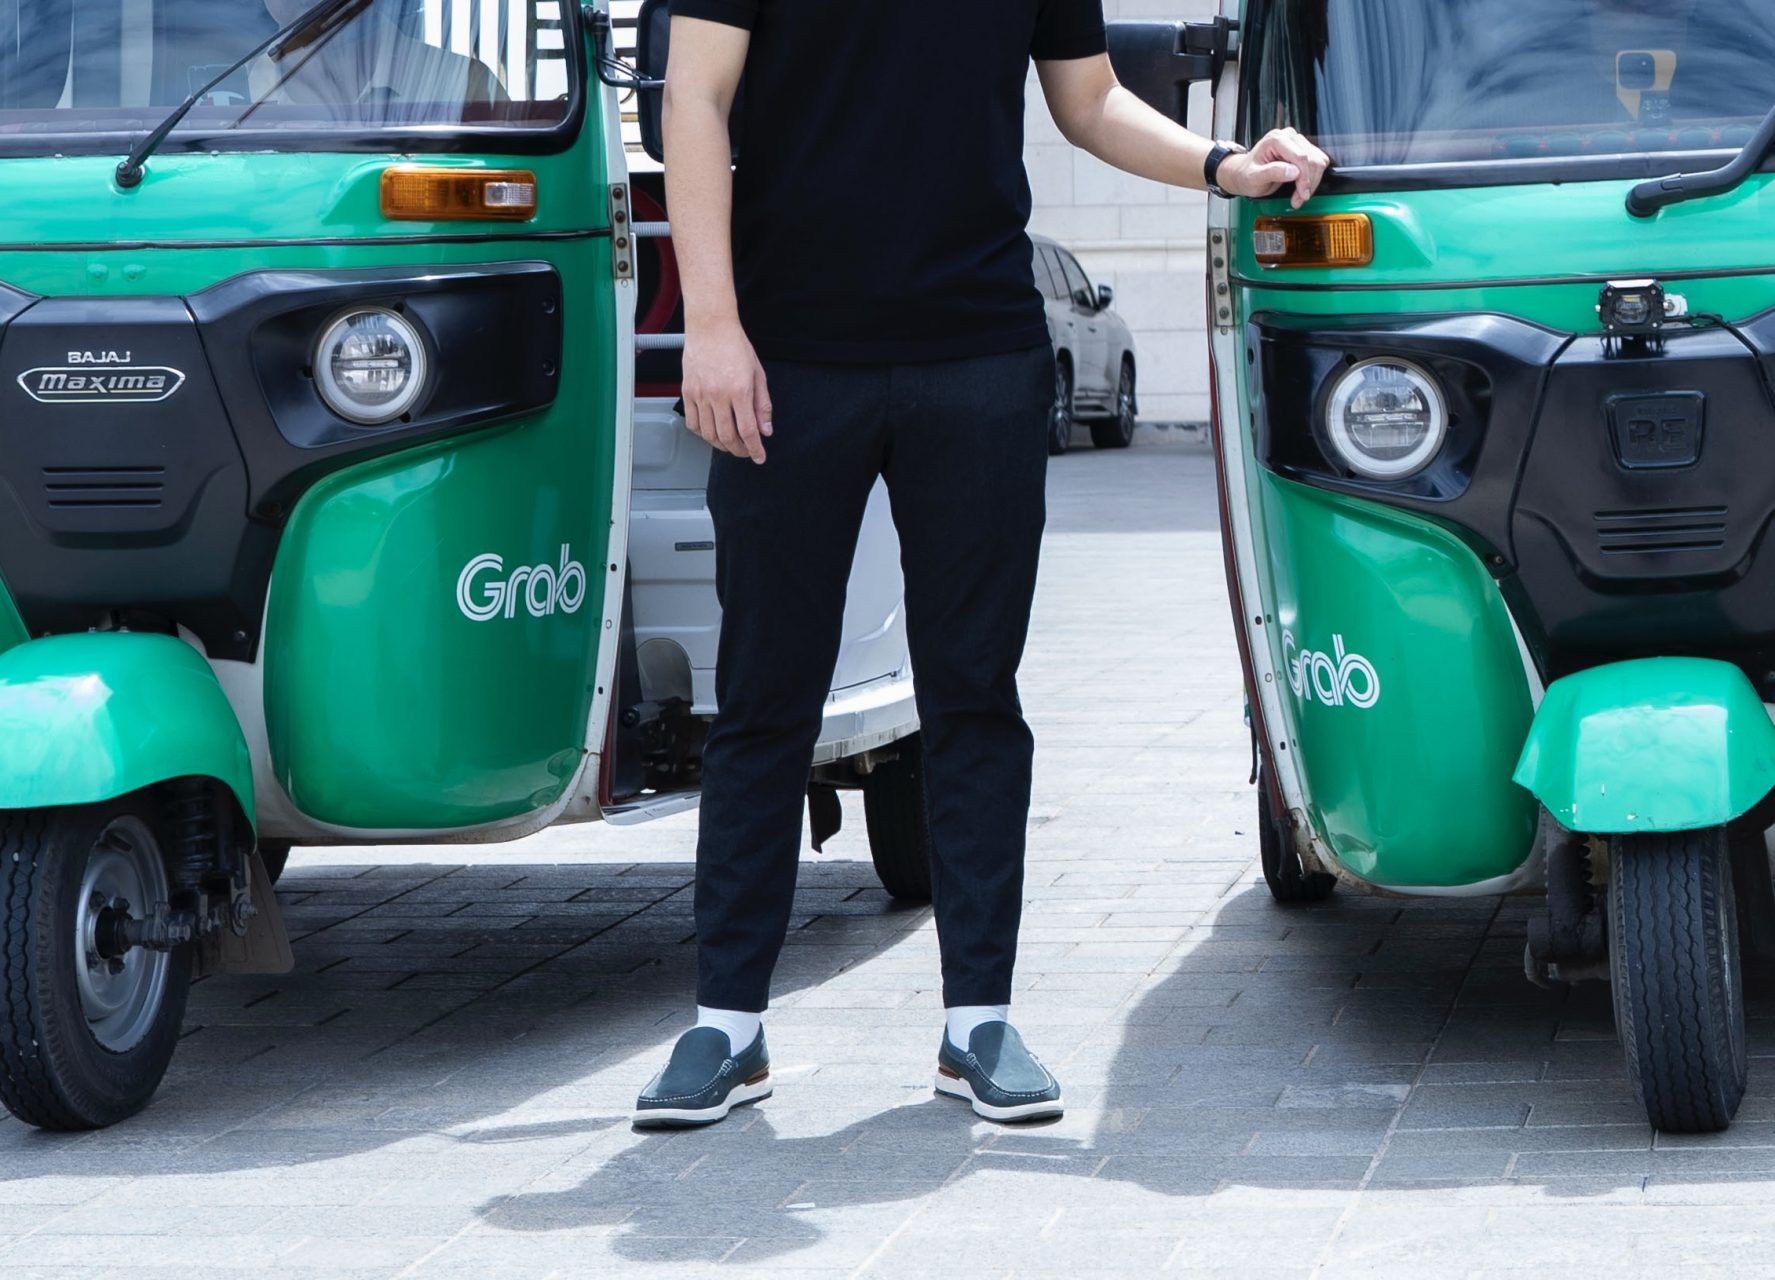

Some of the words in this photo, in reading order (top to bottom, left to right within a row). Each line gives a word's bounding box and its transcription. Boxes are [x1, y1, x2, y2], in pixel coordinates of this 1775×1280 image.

[67, 351, 131, 363] BAJAJ
[38, 373, 166, 393] Maxima
[456, 543, 586, 622] Grab
[1281, 628, 1380, 709] Grab
